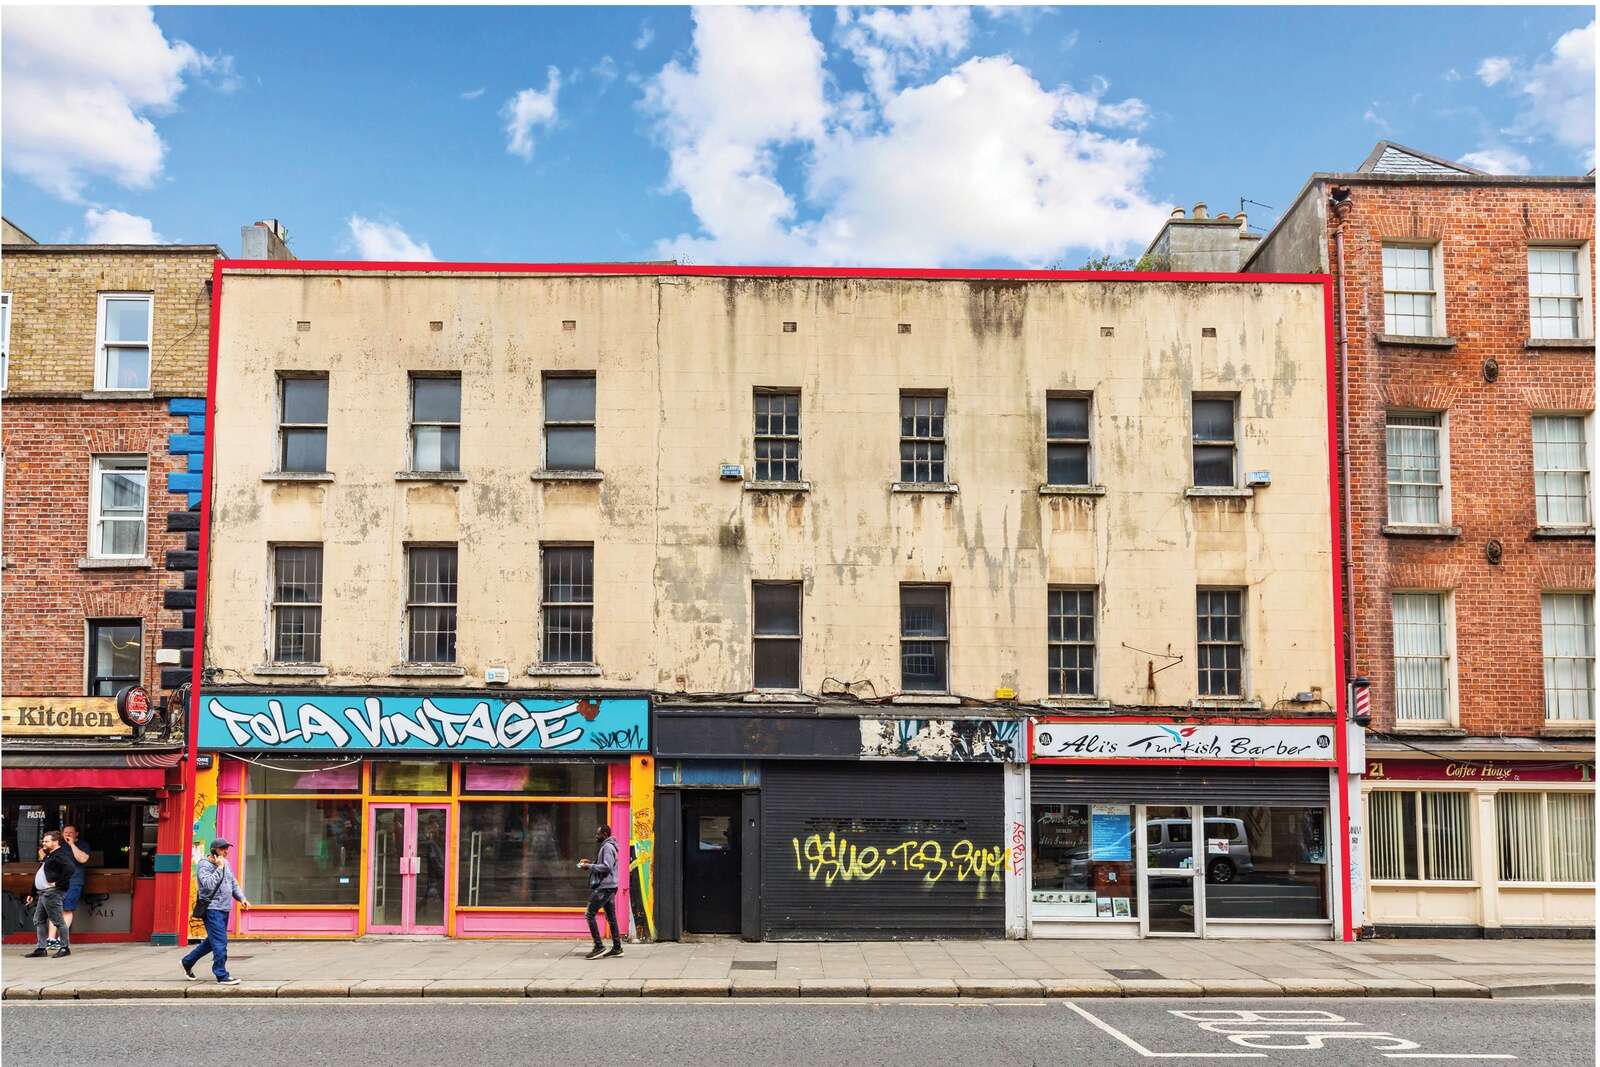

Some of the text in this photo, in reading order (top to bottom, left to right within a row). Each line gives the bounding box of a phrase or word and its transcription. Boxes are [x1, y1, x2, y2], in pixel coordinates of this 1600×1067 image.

[17, 705, 114, 727] Kitchen
[208, 697, 352, 748] TOLA
[344, 696, 585, 750] VINTAGE
[1057, 734, 1312, 757] Ali's Turkish Barber
[1369, 762, 1384, 776] 21
[1446, 763, 1512, 778] Coffee House
[27, 811, 46, 819] PASTA
[1167, 1010, 1421, 1050] BUS
